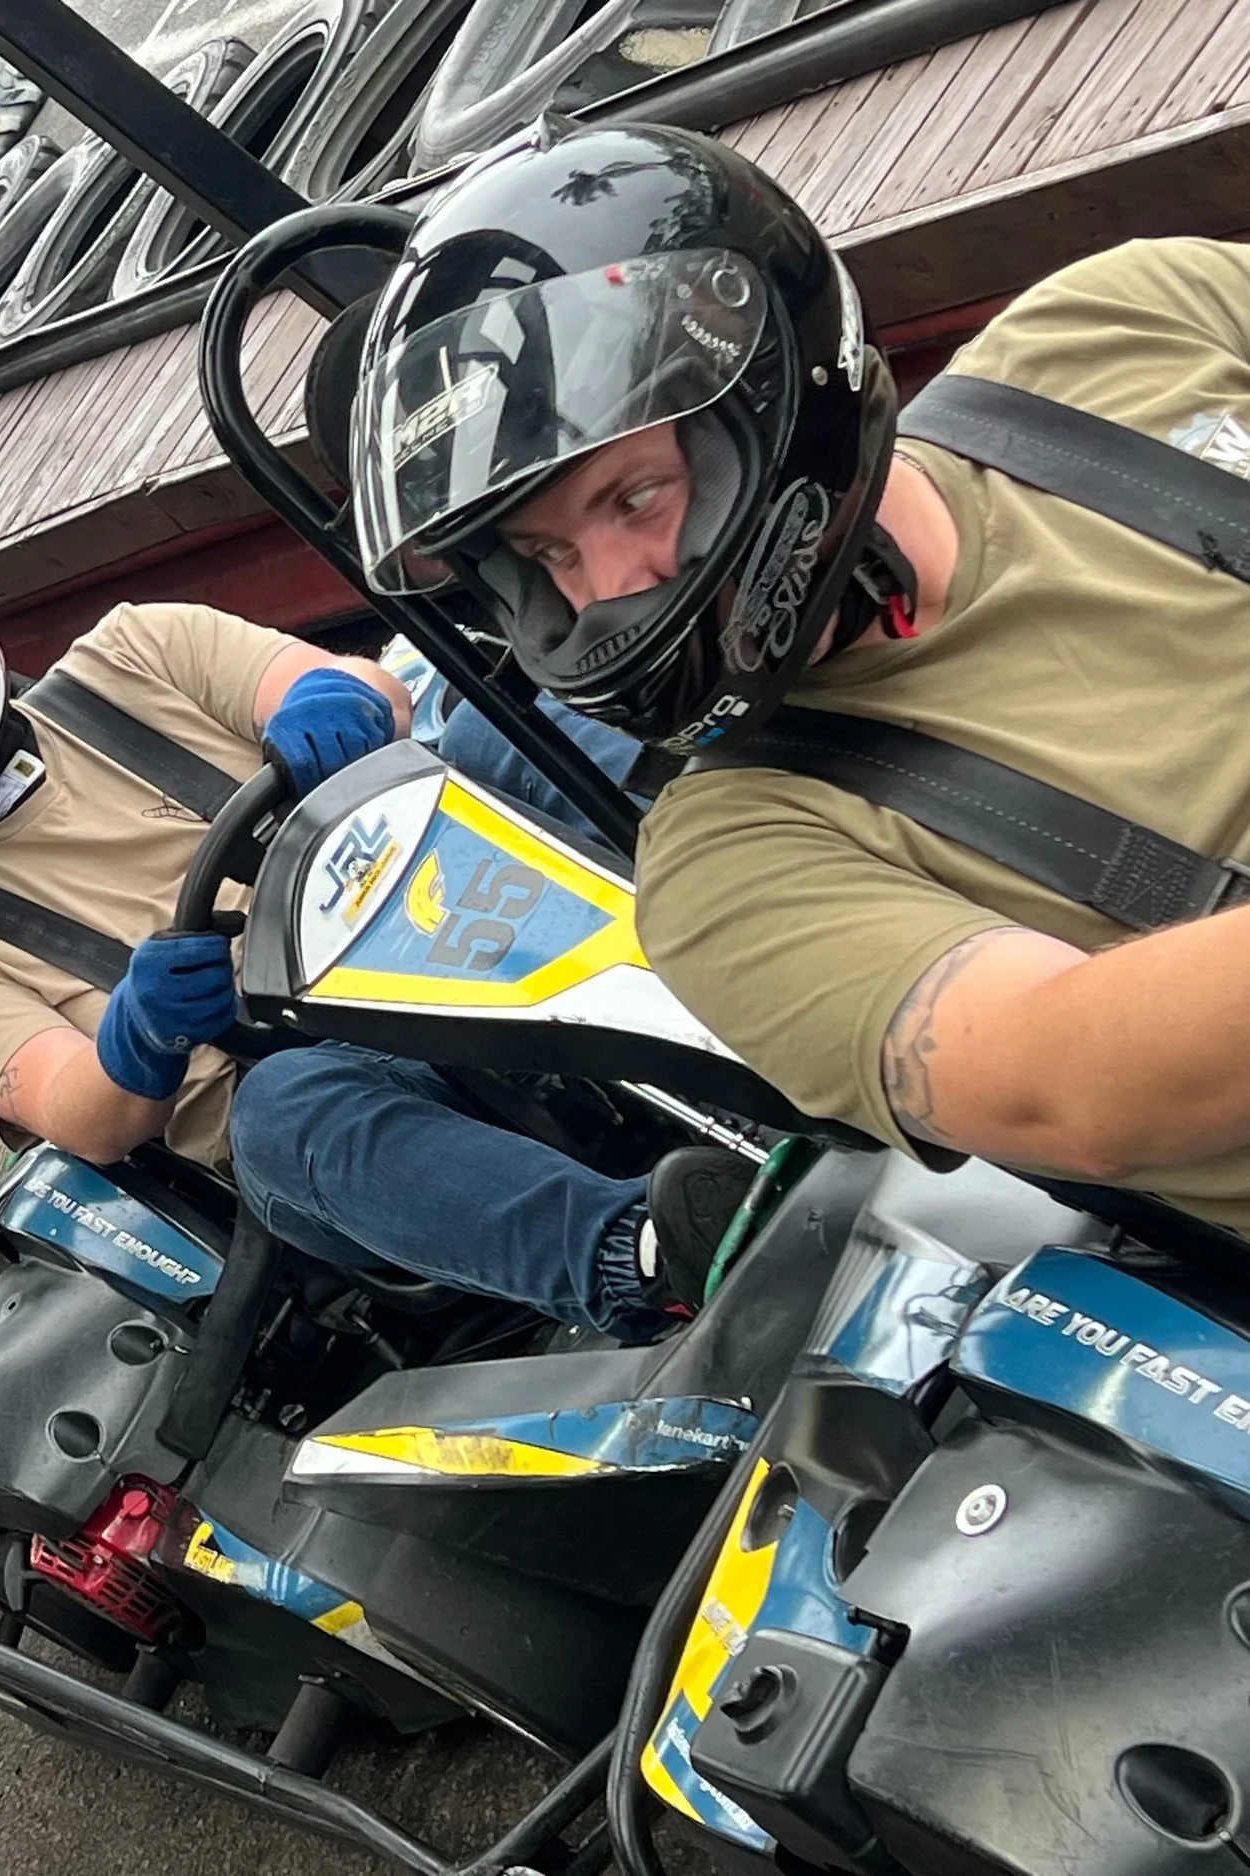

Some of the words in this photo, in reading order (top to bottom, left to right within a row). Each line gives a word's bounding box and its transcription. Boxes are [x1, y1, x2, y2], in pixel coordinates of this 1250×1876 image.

[319, 813, 392, 915] JRL
[426, 858, 547, 971] 55
[47, 1189, 77, 1216] YOU
[72, 1202, 115, 1238] FAST
[113, 1231, 201, 1287] ENOUGH?
[1002, 1287, 1071, 1327] ARE
[1061, 1312, 1131, 1357] YOU
[1119, 1343, 1223, 1404] FAST
